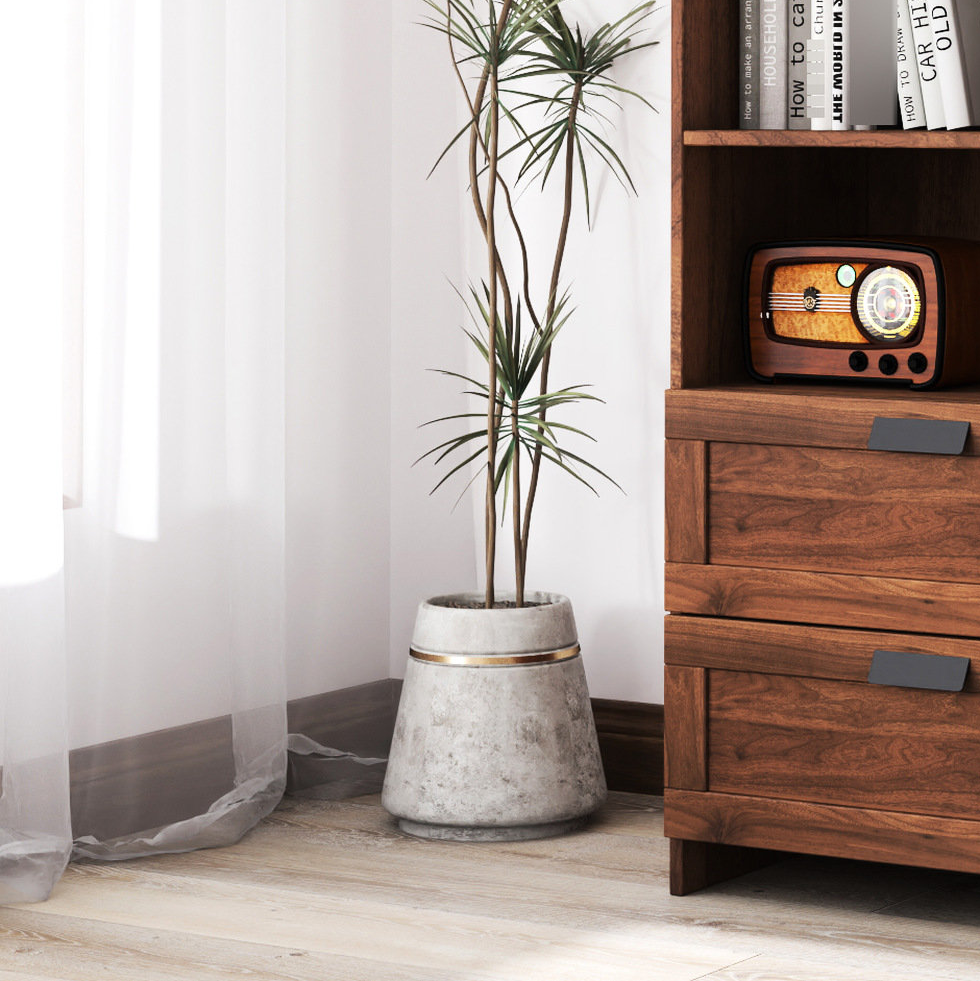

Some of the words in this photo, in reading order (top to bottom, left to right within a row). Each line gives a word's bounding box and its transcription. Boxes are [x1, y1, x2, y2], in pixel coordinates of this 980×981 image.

[931, 5, 953, 51] OLD
[745, 35, 752, 49] an
[791, 41, 805, 65] to
[743, 53, 752, 78] make
[918, 42, 937, 82] CAR
[744, 84, 752, 95] to
[899, 70, 910, 88] TO
[743, 100, 752, 120] How
[790, 79, 805, 119] How
[903, 96, 916, 122] HOW
